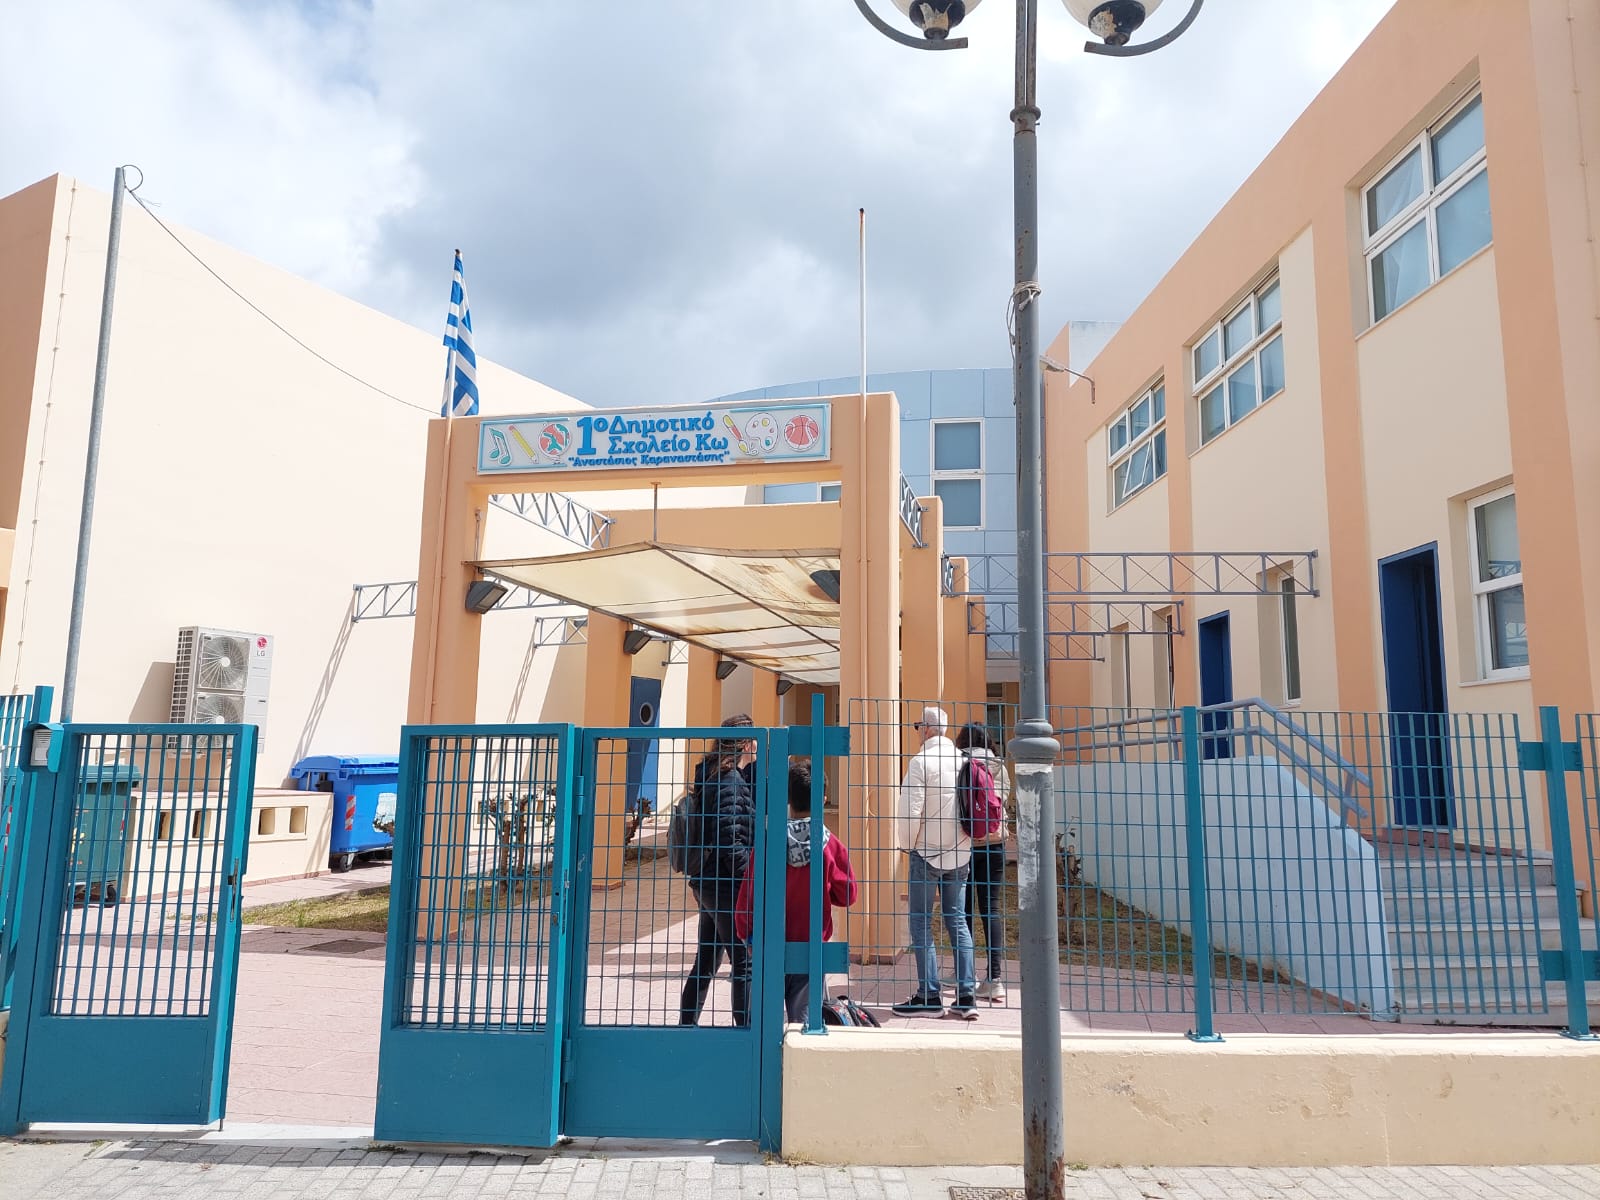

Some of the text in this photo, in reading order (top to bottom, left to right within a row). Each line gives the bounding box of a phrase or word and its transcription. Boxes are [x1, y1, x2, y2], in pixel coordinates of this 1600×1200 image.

[608, 411, 715, 438] Δημοτικό
[607, 433, 729, 455] Σχολείο Κω
